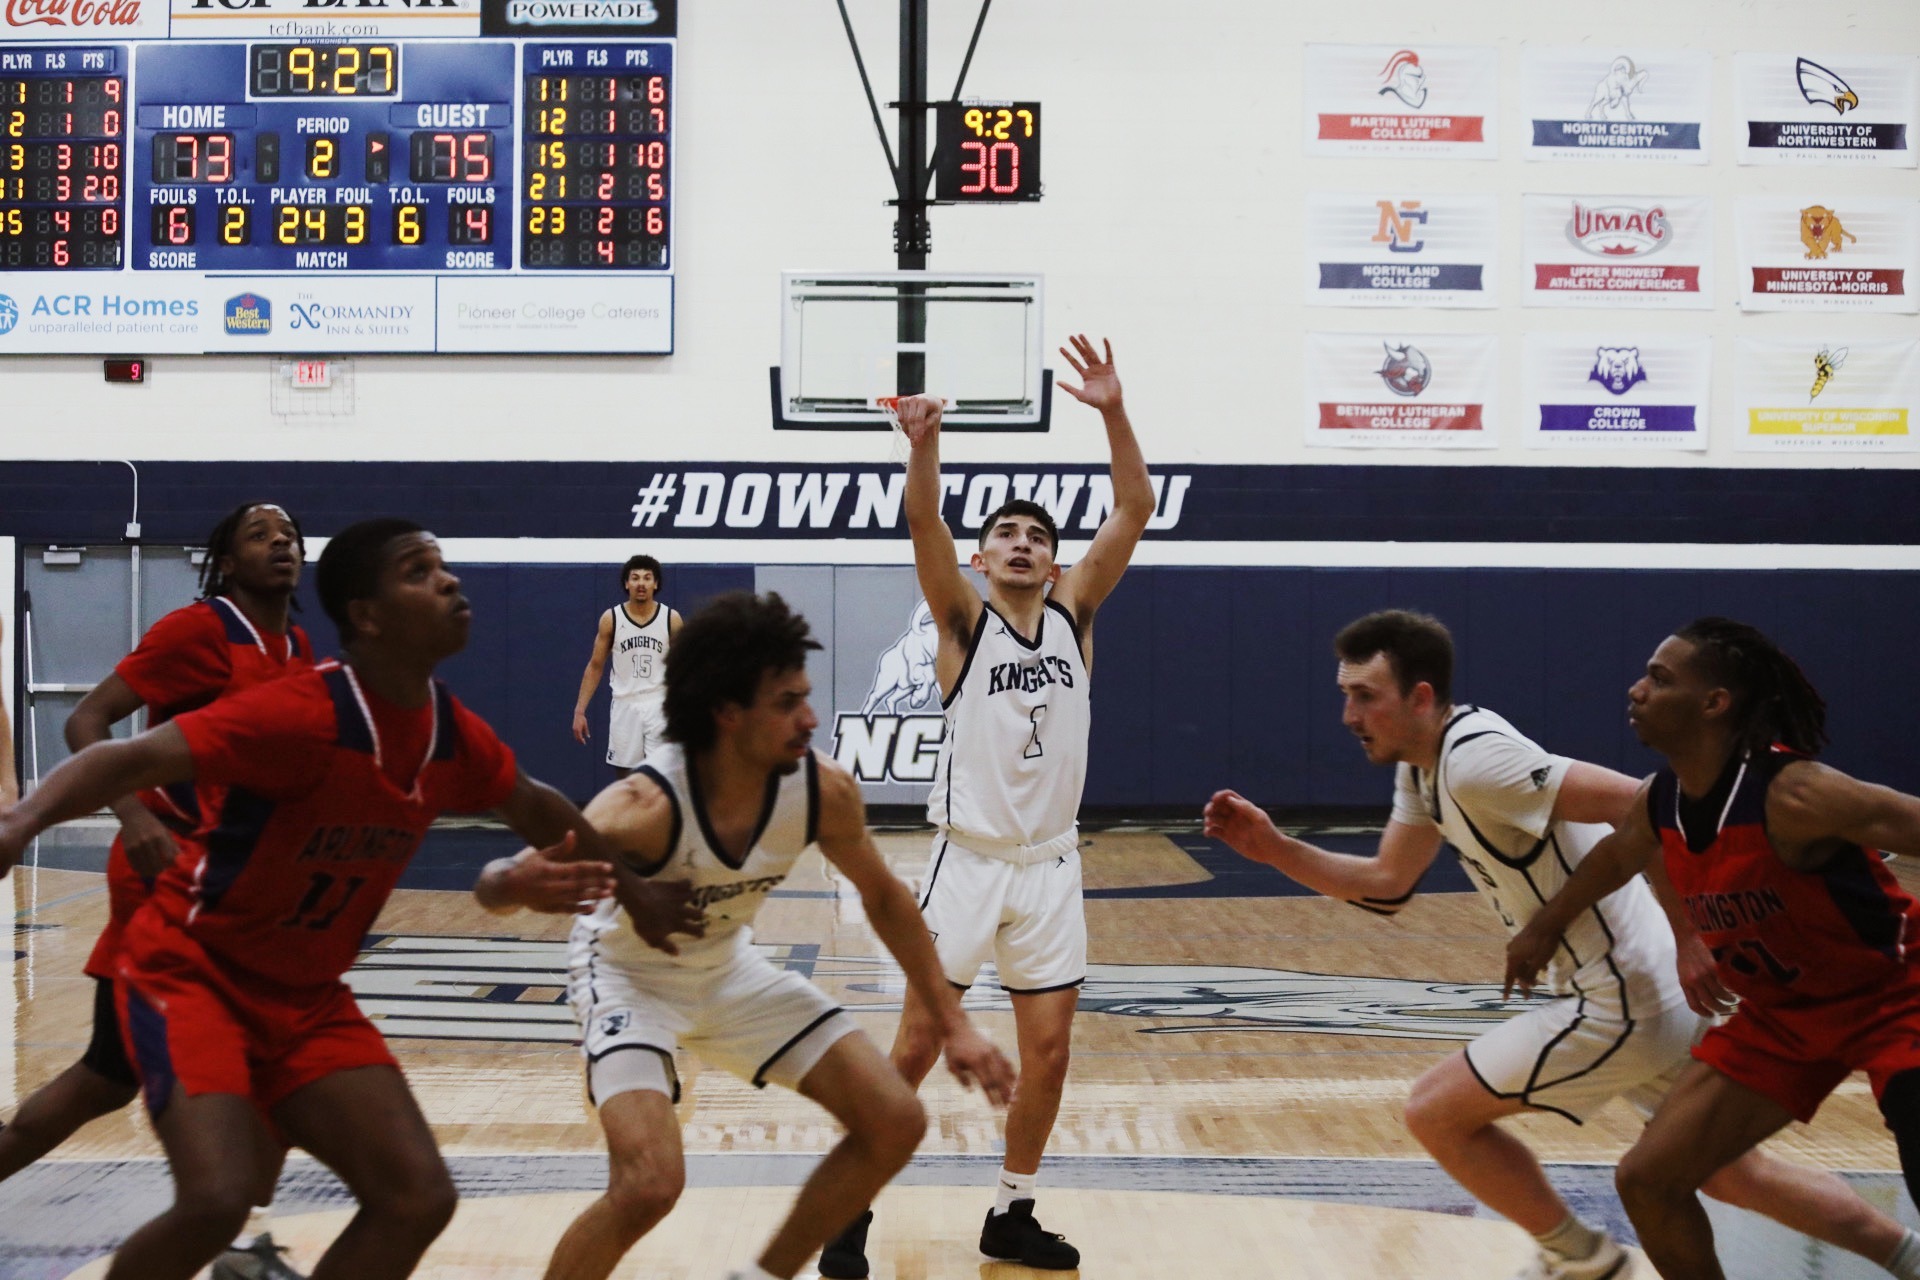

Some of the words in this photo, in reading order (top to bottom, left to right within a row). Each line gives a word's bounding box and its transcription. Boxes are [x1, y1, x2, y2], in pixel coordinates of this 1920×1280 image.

[512, 2, 648, 18] POWERADE
[269, 21, 379, 35] tcfbank.com
[3, 54, 32, 69] PLYR
[45, 53, 66, 69] FLS
[83, 53, 104, 68] PTS
[542, 49, 573, 66] PLYR
[587, 49, 608, 66] FLS
[626, 49, 648, 66] PTS
[289, 47, 393, 94] 9:27
[66, 82, 73, 103] 1
[104, 79, 120, 103] 9
[540, 78, 567, 101] 11
[609, 78, 615, 101] 1
[648, 77, 664, 103] 6
[9, 111, 25, 137] 2
[66, 113, 72, 135] 1
[104, 110, 119, 136] 0
[163, 105, 226, 128] HOME
[296, 117, 349, 134] PERIOD
[417, 104, 490, 128] GUEST
[540, 107, 567, 135] 12
[609, 110, 615, 133] 1
[650, 108, 664, 133] 7
[964, 109, 1033, 139] 9:27
[1350, 116, 1399, 127] MARTIN
[1401, 117, 1451, 128] LUTHER
[1371, 128, 1431, 139] COLLEGE
[1562, 123, 1607, 135] NORTH
[1610, 124, 1669, 136] CENTRAL
[1782, 124, 1853, 136] UNIVERSITY
[1856, 125, 1873, 136] OF
[1578, 134, 1654, 147] UNIVERSITY
[1777, 135, 1877, 147] NORTHWESTERN
[10, 144, 24, 170] 3
[57, 144, 71, 170] 3
[94, 144, 118, 170] 10
[176, 135, 230, 182] 73
[312, 139, 333, 177] 2
[434, 134, 489, 181] 75
[540, 141, 566, 169] 15
[609, 144, 615, 167] 1
[638, 141, 664, 168] 10
[961, 141, 1019, 193] 30
[57, 175, 70, 201] 3
[83, 175, 118, 201] 20
[150, 188, 197, 204] FOULS
[215, 188, 255, 204] T.O.L.
[270, 188, 326, 204] PLAYER
[335, 187, 373, 204] FOUL
[389, 187, 430, 204] T.O.L.
[447, 187, 496, 204] FOULS
[529, 173, 566, 200] 21
[598, 173, 614, 200] 2
[647, 173, 663, 200] 5
[54, 211, 70, 233] 4
[102, 208, 117, 235] 0
[169, 206, 190, 244] 6
[224, 206, 245, 244] 2
[278, 206, 326, 244] 24
[346, 206, 365, 244] 3
[398, 206, 420, 244] 6
[466, 209, 487, 241] 4
[529, 206, 566, 235] 23
[598, 206, 614, 234] 2
[647, 207, 663, 235] 6
[1574, 203, 1665, 240] UMAC
[54, 240, 69, 266] 6
[149, 252, 196, 268] SCORE
[296, 251, 347, 268] MATCH
[446, 251, 494, 268] SCORE
[597, 240, 614, 264] 4
[1362, 265, 1440, 277] NORTHLAND
[1570, 266, 1610, 278] UPPER
[1612, 267, 1665, 279] MIDWEST
[1781, 270, 1853, 282] UNIVERSITY
[1856, 271, 1873, 282] OF
[1371, 277, 1431, 288] COLLEGE
[1549, 277, 1605, 289] ATHLETIC
[1607, 278, 1686, 290] CONFERENCE
[1766, 281, 1889, 293] MINNESOTA-MORRIS
[31, 295, 91, 316] ACR
[102, 294, 199, 317] Homes
[235, 307, 260, 319] Best
[457, 302, 516, 319] Pioneer
[521, 301, 586, 321] College
[591, 301, 660, 319] Caterers
[226, 316, 270, 329] Western
[290, 303, 414, 329] NORMANDY
[29, 320, 112, 334] unparalleled
[116, 320, 164, 334] patient
[170, 323, 198, 333] care
[326, 324, 350, 335] INN
[368, 324, 410, 335] SUITES
[131, 363, 141, 379] 9
[298, 361, 326, 384] EXIT
[1336, 405, 1395, 416] BETHANY
[1399, 405, 1466, 417] LUTHERAN
[1594, 407, 1640, 418] CROWN
[1371, 417, 1431, 428] COLLEGE
[1587, 418, 1647, 430] COLLEGE
[620, 635, 663, 654] KNIGHTS
[632, 654, 652, 678] 15
[987, 655, 1074, 696] KNGHTS
[1023, 704, 1047, 759] 1
